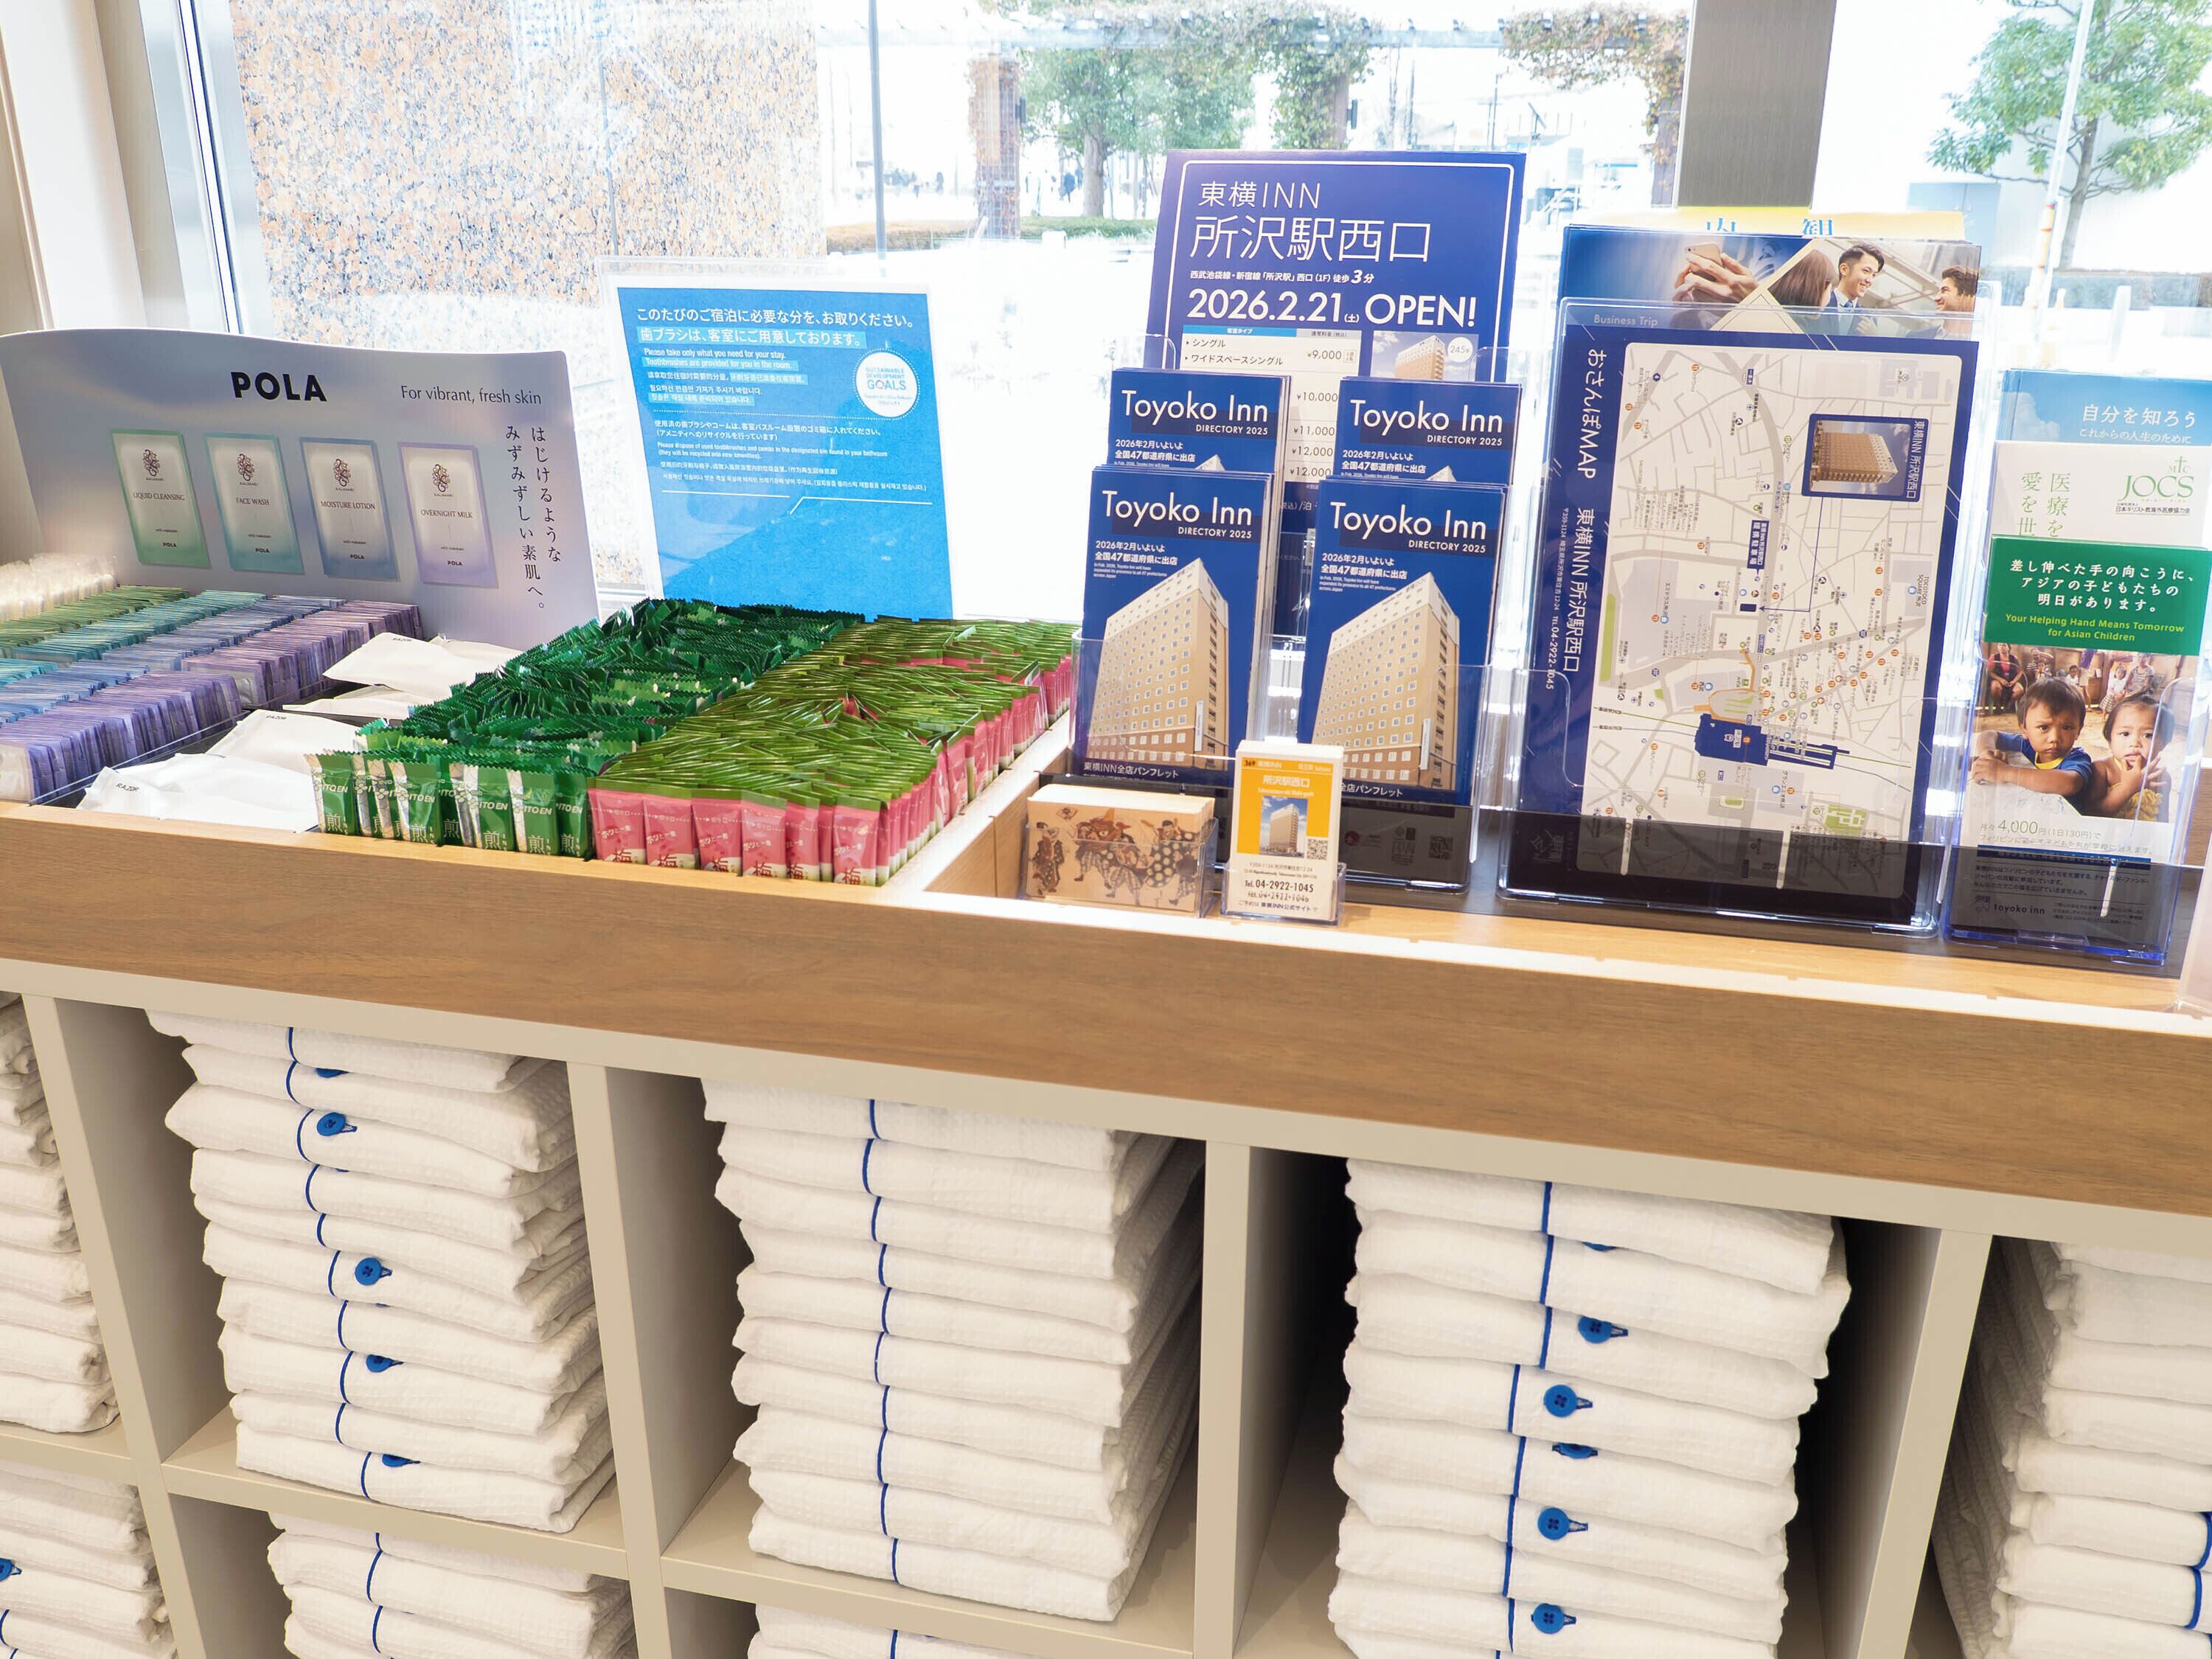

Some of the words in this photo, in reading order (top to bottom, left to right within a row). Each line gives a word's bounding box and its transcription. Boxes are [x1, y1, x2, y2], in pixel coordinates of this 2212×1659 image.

[1197, 181, 1320, 209] 東横INN
[1190, 215, 1432, 263] 所沢駅西口
[1186, 288, 1342, 323] 2026.2.21
[1364, 293, 1477, 327] OPEN!
[637, 307, 914, 328] このたびのご宿泊に必要な分を、お取りください。
[1593, 314, 1636, 326] Business
[1639, 316, 1658, 327] Trip
[641, 327, 860, 347] 歯ブラシは、客室にご用意しております。
[1192, 338, 1226, 348] シングル
[644, 347, 666, 356] Please
[667, 349, 681, 357] take
[682, 349, 695, 358] only
[698, 349, 713, 358] what
[714, 351, 726, 359] you
[755, 352, 769, 360] your
[771, 352, 787, 361] stay.
[1191, 354, 1284, 366] ワイドスペースシングル
[1307, 349, 1342, 360] ¥9,000
[231, 371, 327, 403] POLA
[867, 379, 906, 391] GOALS
[400, 385, 427, 400] For
[428, 386, 476, 405] vibrant,
[479, 387, 511, 403] fresh
[515, 389, 542, 405] skin
[1297, 392, 1338, 403] ¥10,000
[1121, 389, 1217, 425] Toyoko
[1228, 394, 1268, 423] Inn
[1578, 348, 1607, 479] おさんぽMAP
[1350, 399, 1450, 436] Toyoko
[1461, 404, 1503, 434] Inn
[2081, 403, 2197, 428] 自分を知ろう
[1195, 424, 1243, 434] DIRECTORY
[1246, 425, 1268, 436] 2025
[1293, 425, 1335, 437] ¥11,000
[2079, 428, 2192, 444] これからの人生のために
[1115, 439, 1183, 451] 2026年2月いよいよ
[1427, 434, 1477, 445] DIRECTORY
[1479, 437, 1503, 446] 2025
[1114, 450, 1196, 463] 全国47都道府県に出店
[1292, 446, 1333, 457] ¥12,000
[1343, 449, 1413, 462] 2026年2月いよいよ
[1290, 467, 1332, 477] ¥12,000
[1341, 461, 1427, 474] 全国47都道府県に出店
[531, 425, 561, 563] はじけるような
[2118, 475, 2194, 501] JOCS
[236, 497, 251, 505] FACE
[251, 498, 270, 506] WASH
[321, 501, 352, 509] MOISTURE
[352, 501, 375, 510] LOTION
[1102, 490, 1200, 527] Toyoko
[1211, 496, 1252, 526] Inn
[2047, 472, 2071, 538] 医療を
[420, 509, 457, 518] OVERNIGHT
[457, 510, 473, 518] MILK
[506, 425, 545, 609] みずみずしい素肌へ。
[1330, 501, 1432, 540] Toyoko
[1444, 509, 1486, 540] Inn
[1178, 526, 1227, 538] DIRECTORY
[1229, 529, 1252, 539] 2025
[1096, 540, 1166, 552] 2026年2月いよいよ
[1408, 539, 1460, 552] DIRECTORY
[1462, 543, 1486, 553] 2025
[1571, 507, 1596, 577] 東横INN
[1094, 552, 1178, 566] 全国47都道府県に出店
[1322, 553, 1395, 566] 2026年2月いよいよ
[1321, 564, 1408, 580] 全国47都道府県に出店
[2009, 558, 2197, 582] 差し伸べた手の向こうに、
[2020, 576, 2180, 597] アジアの子どもたちの
[2037, 593, 2157, 613] 明日があります。
[1562, 580, 1587, 672] 所沢駅西口
[2006, 613, 2027, 623] Your
[2029, 614, 2067, 627] Helping
[2069, 616, 2097, 627] Hand
[2098, 618, 2131, 630] Means
[2132, 620, 2185, 633] Tomorrow
[2048, 627, 2062, 637] for
[2064, 629, 2092, 639] Asian
[2093, 630, 2135, 641] Children
[1083, 762, 1180, 779] 東横INN全店パンフレット
[524, 805, 539, 814] ITO
[540, 807, 552, 815] EN
[1255, 879, 1315, 893] 04-2922-1045
[1994, 903, 2027, 914] toyoko
[2030, 905, 2045, 914] inn
